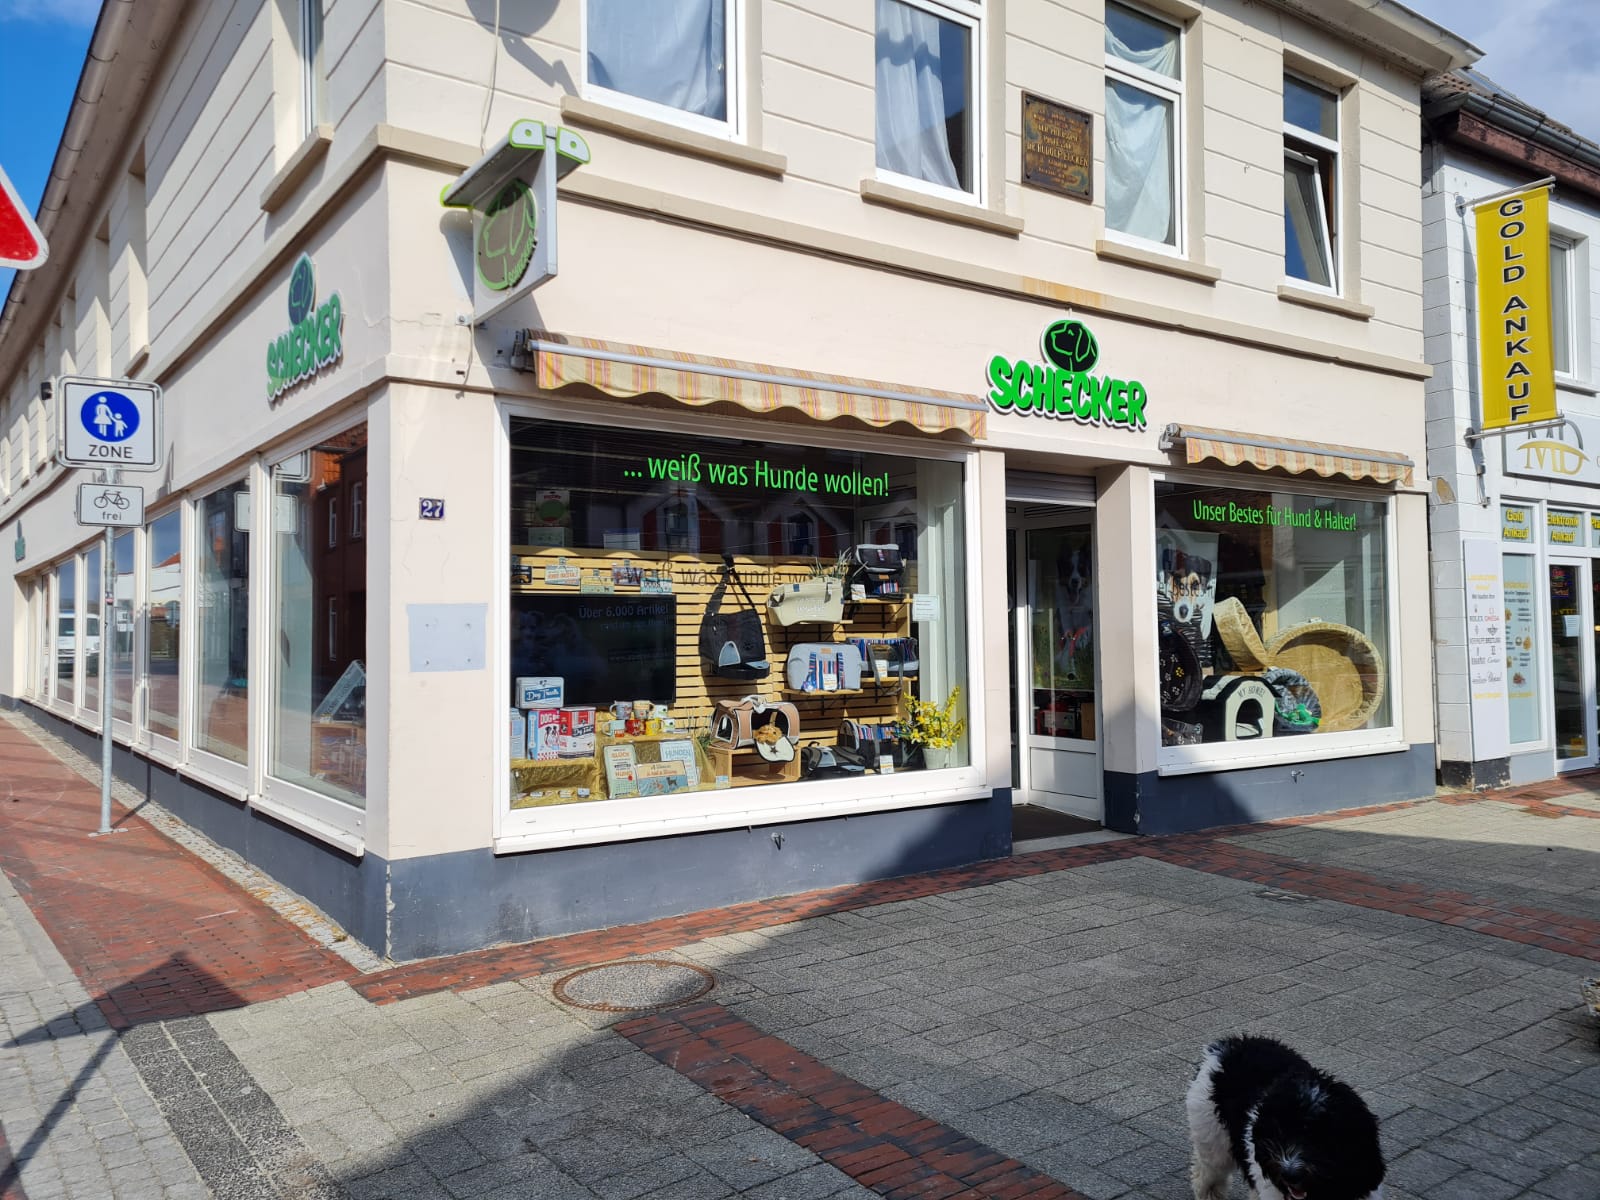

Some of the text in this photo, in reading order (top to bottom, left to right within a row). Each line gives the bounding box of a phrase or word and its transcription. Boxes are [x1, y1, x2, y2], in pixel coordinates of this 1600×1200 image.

[1499, 199, 1531, 422] GOLD ANKAUF
[267, 292, 342, 399] SCHECKER
[987, 354, 1148, 429] SCHECKER
[88, 444, 134, 459] ZONE
[647, 453, 701, 483] weiß
[708, 462, 748, 486] was
[754, 459, 818, 492] Hunde
[824, 471, 890, 497] wollen!
[101, 511, 122, 521] frei
[422, 499, 443, 518] 27
[1193, 499, 1357, 531] Unser Bestes für Hund & Halter!
[1506, 508, 1525, 523] Gold
[1503, 526, 1529, 540] Ankauf
[1551, 530, 1576, 543] Ankauf
[578, 603, 669, 619] Über 6.000 Artikel
